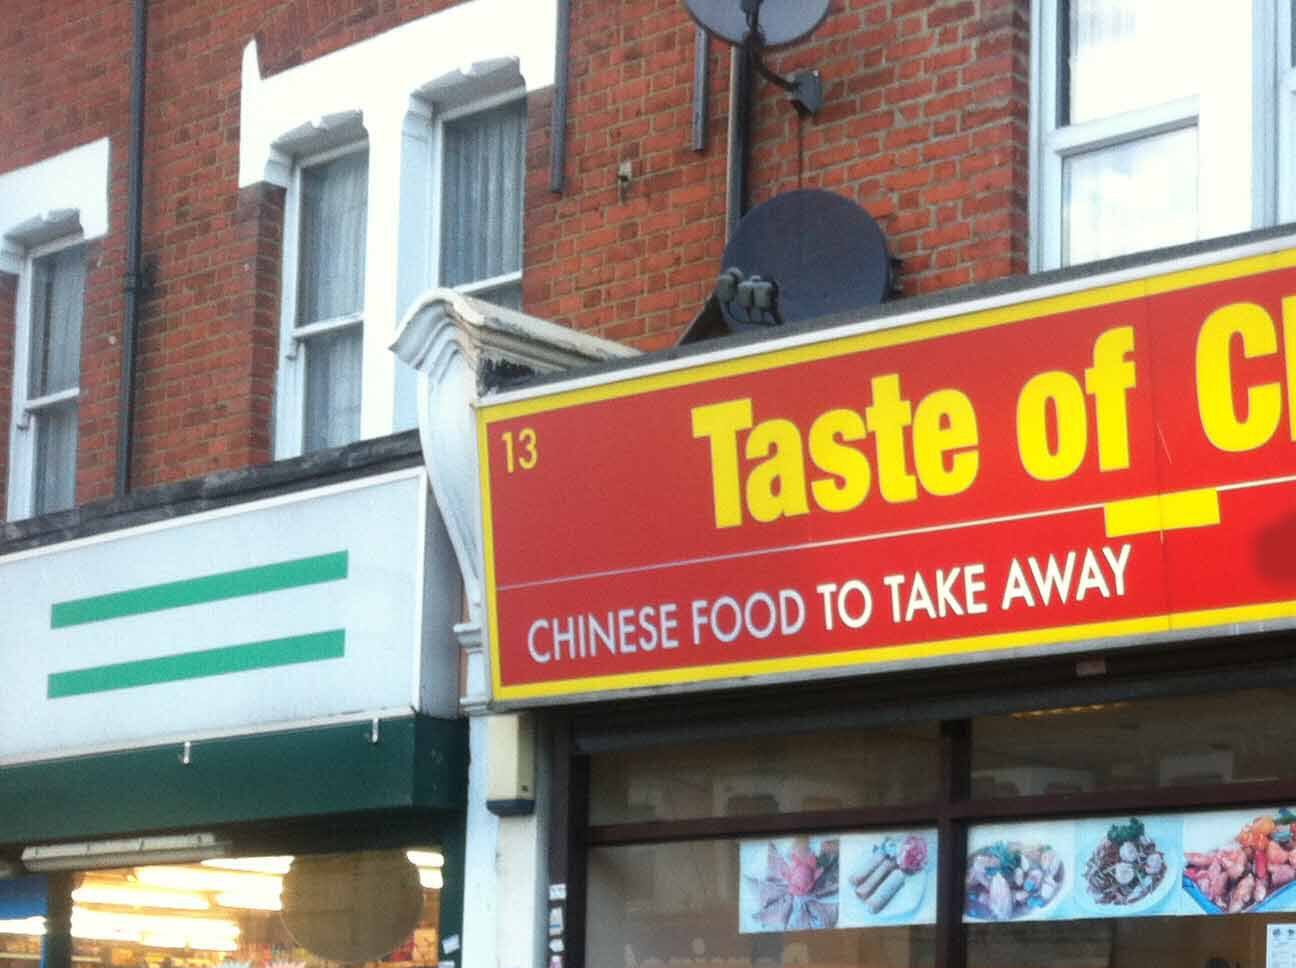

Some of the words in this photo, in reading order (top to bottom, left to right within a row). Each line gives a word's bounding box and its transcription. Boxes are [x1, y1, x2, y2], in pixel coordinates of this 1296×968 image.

[502, 428, 538, 473] 13
[691, 373, 981, 529] Taste
[1016, 326, 1137, 482] of
[527, 602, 679, 664] CHINESE
[691, 588, 807, 646] FOOD
[816, 578, 874, 631] TO
[883, 564, 987, 624] TAKE
[1001, 543, 1133, 610] AWAY
